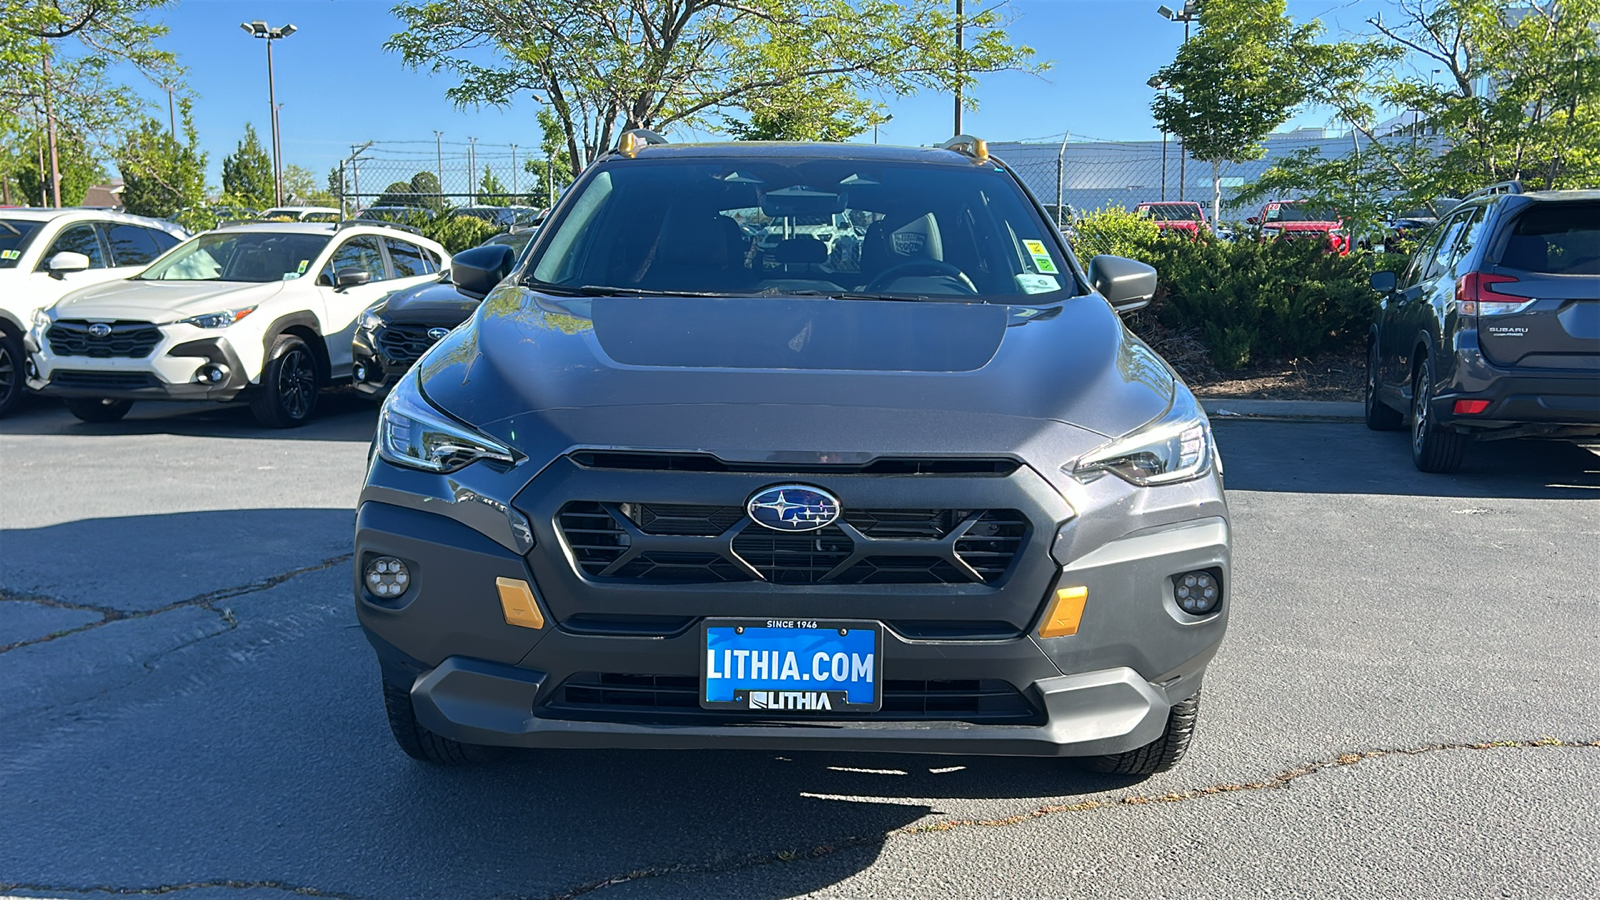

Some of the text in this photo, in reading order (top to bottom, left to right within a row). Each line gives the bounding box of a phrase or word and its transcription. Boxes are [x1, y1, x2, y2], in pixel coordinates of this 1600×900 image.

[766, 620, 794, 628] SINCE
[707, 649, 874, 683] LITHIA.COM
[767, 691, 832, 710] LITHIA
